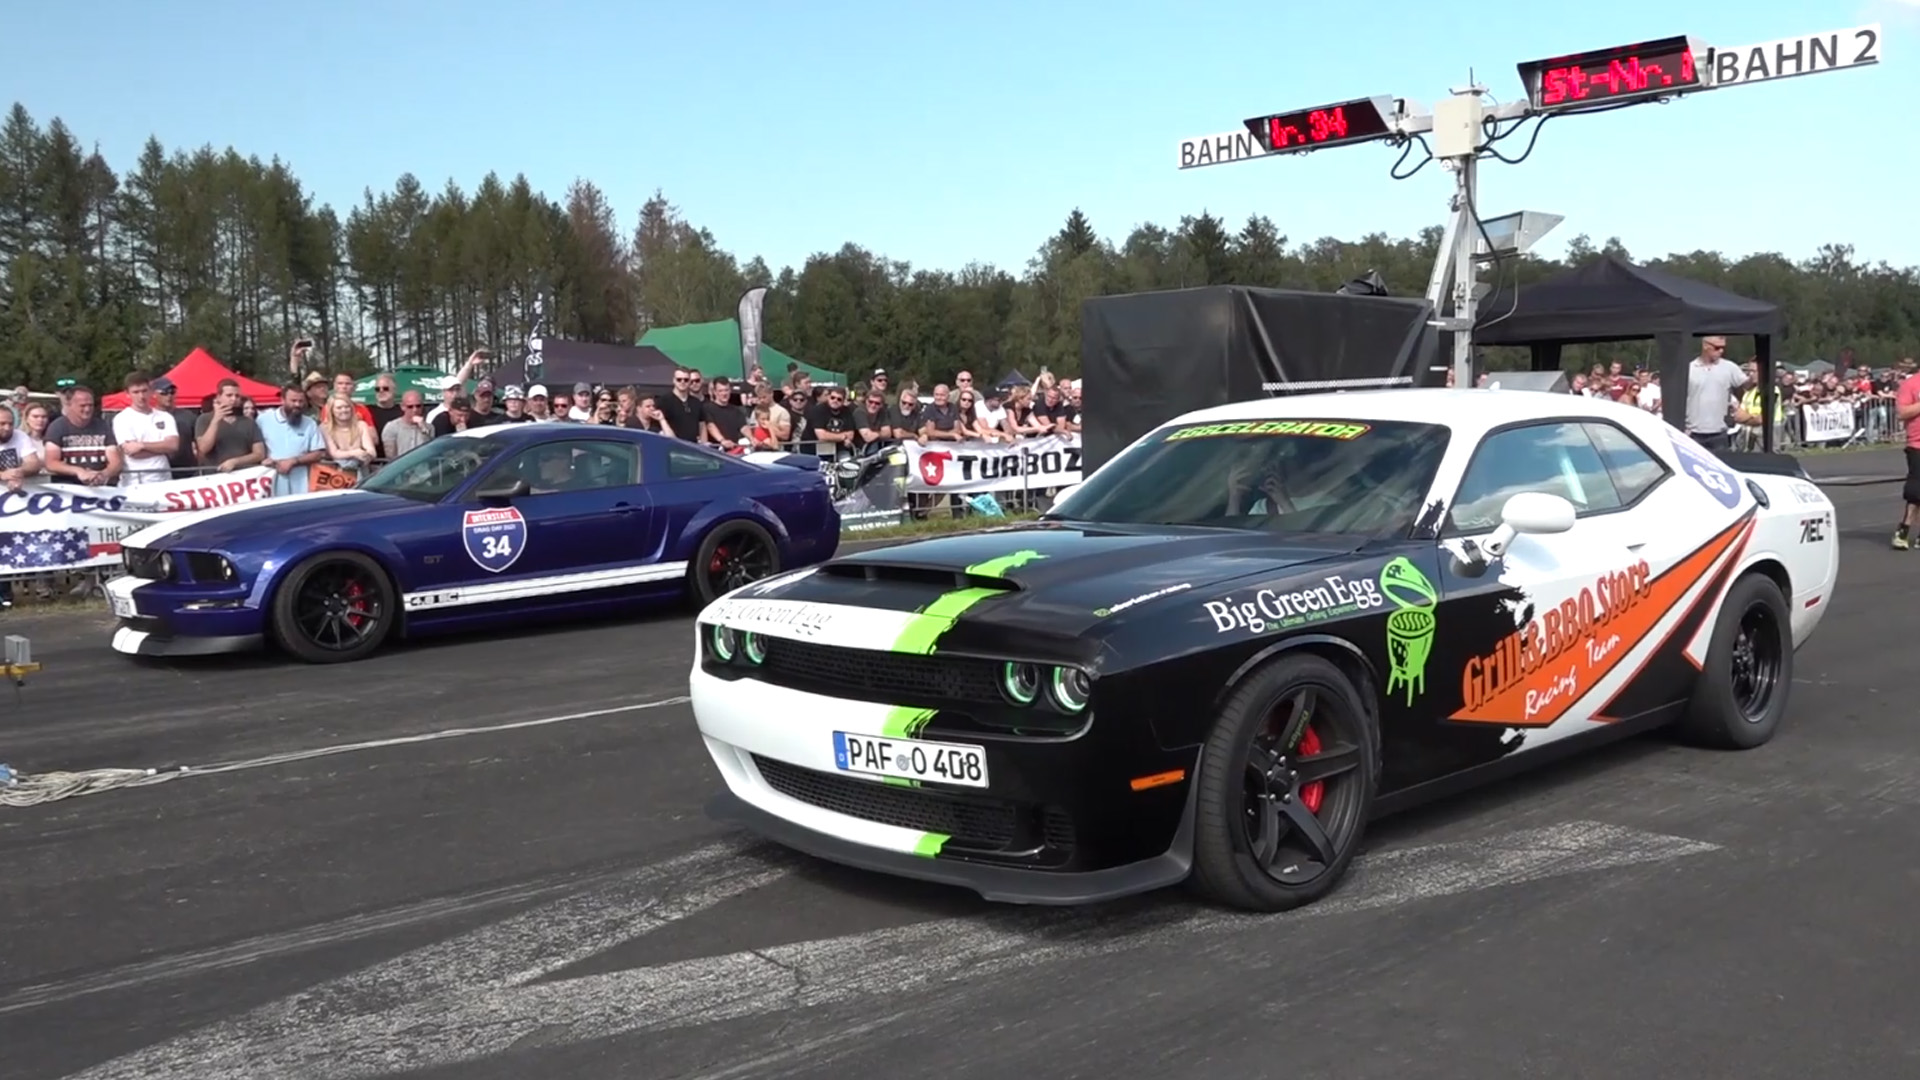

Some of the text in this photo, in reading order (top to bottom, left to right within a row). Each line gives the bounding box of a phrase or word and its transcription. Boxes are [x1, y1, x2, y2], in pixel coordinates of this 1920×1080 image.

[1717, 34, 1838, 84] BAHN
[1852, 29, 1877, 63] 2
[1308, 106, 1348, 142] 34
[1181, 132, 1252, 166] BAHN
[98, 524, 121, 543] THE
[471, 510, 513, 524] INTERSTATE
[482, 534, 512, 559] 34
[1203, 597, 1266, 634] Big
[1256, 588, 1337, 620] Green
[1325, 575, 1383, 610] Egg
[1266, 621, 1279, 631] The
[1524, 633, 1621, 720] Racing Team
[848, 738, 893, 770] PAF
[932, 748, 982, 782] 408
